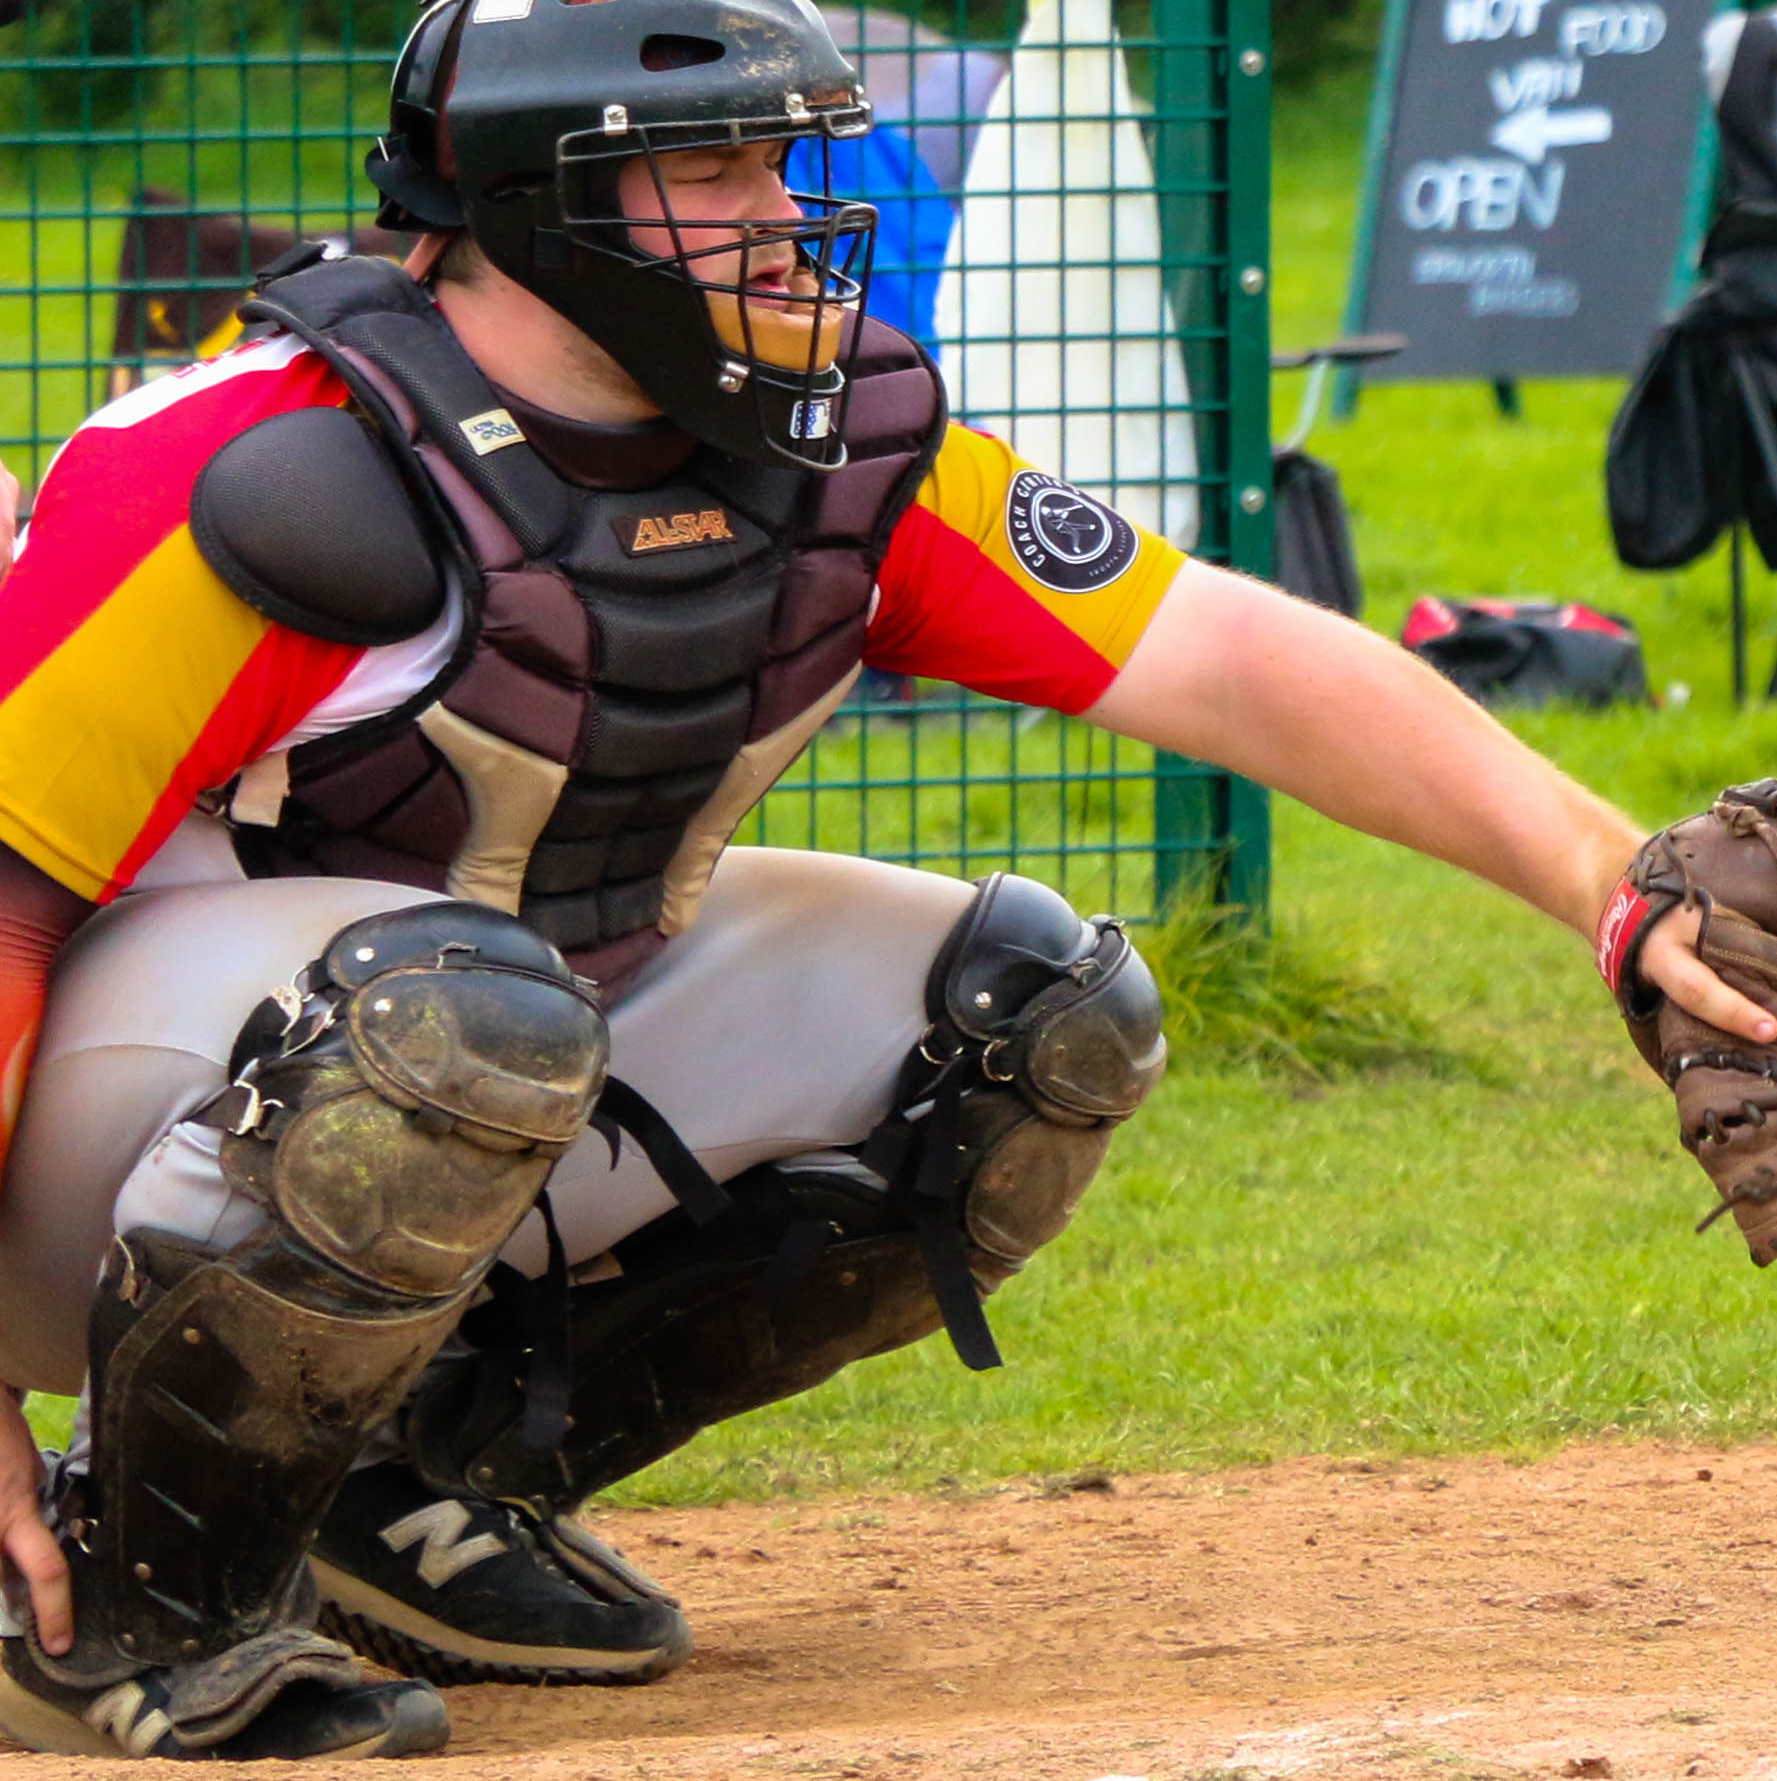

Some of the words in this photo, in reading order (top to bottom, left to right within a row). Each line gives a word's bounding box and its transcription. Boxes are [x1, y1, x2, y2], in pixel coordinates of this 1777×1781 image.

[1559, 1, 1668, 58] FOOD
[1401, 155, 1567, 231] OPEN
[1014, 505, 1046, 568] COACH
